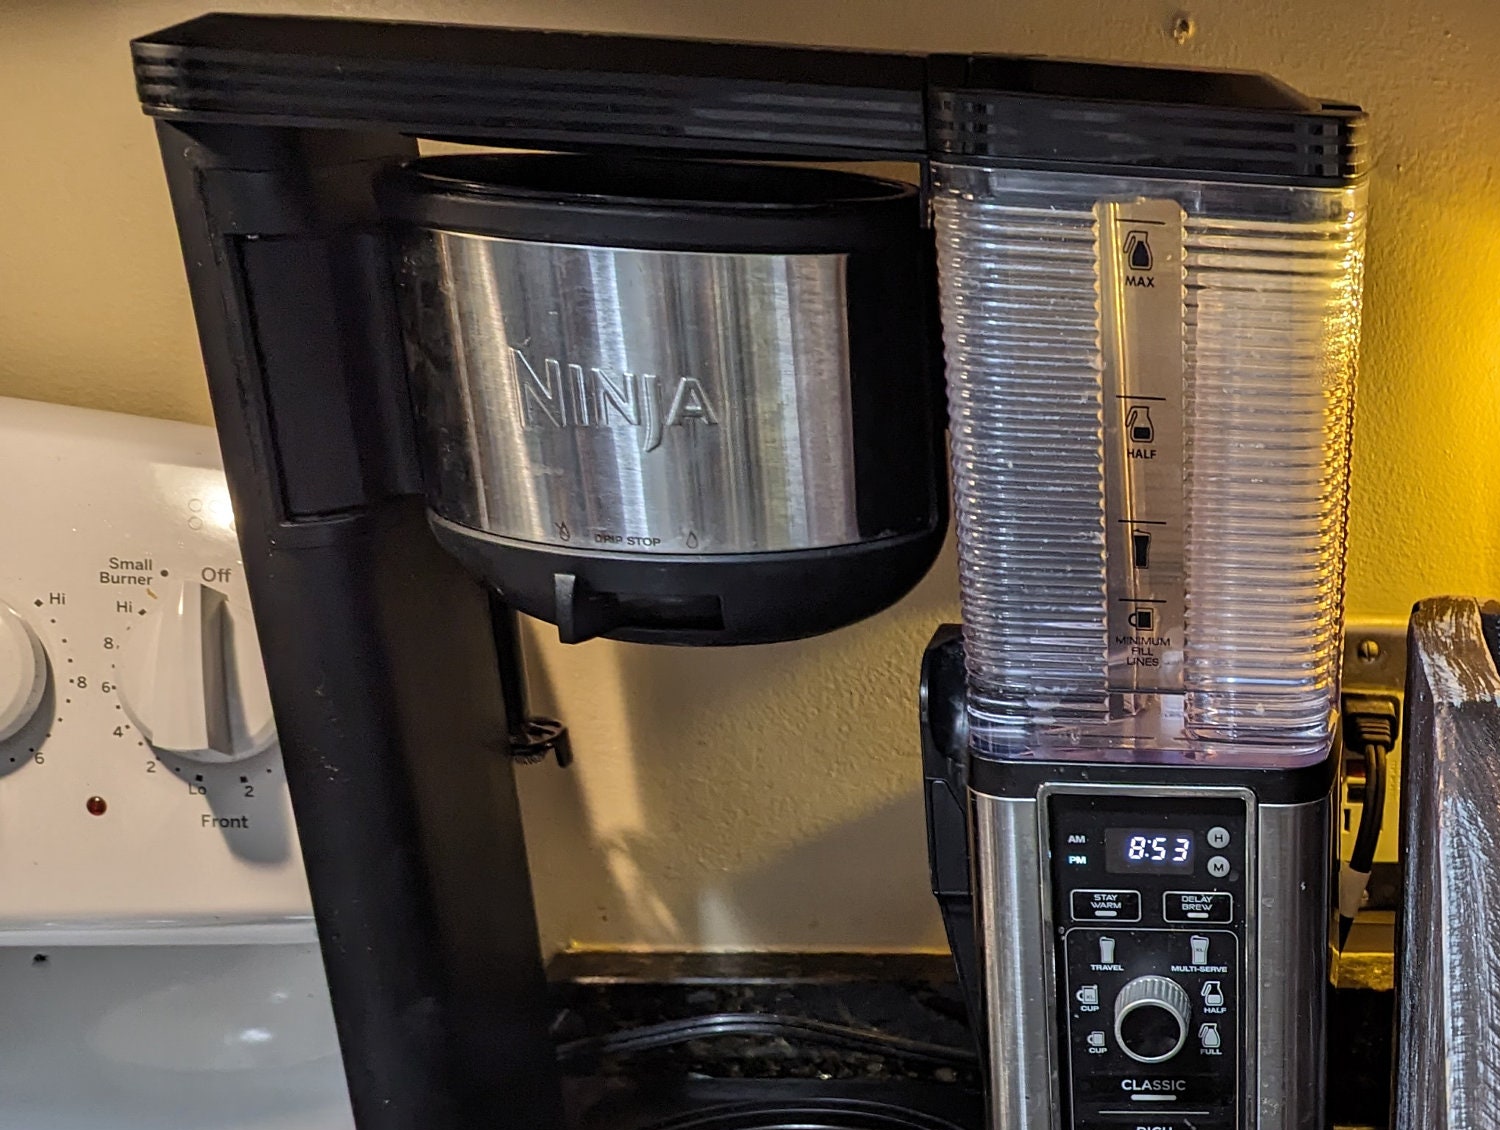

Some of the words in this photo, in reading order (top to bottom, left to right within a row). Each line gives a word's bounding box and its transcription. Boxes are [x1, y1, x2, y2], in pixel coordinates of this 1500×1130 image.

[1125, 275, 1155, 288] MAX
[508, 347, 719, 453] NINJA
[1126, 448, 1157, 459] HALF
[594, 533, 623, 544] DRIP
[626, 535, 661, 547] STOP
[109, 557, 153, 571] Small
[100, 572, 153, 586] Burner
[201, 567, 232, 583] Off
[50, 593, 66, 605] Hi
[116, 601, 133, 613] Hi
[103, 637, 114, 649] 8
[1126, 656, 1159, 667] LINES
[77, 676, 87, 688] 8
[101, 682, 111, 693] 6
[113, 727, 123, 738] 4
[34, 752, 45, 764] 6
[146, 762, 156, 773] 2
[189, 783, 207, 796] Lo
[244, 786, 254, 798] 2
[202, 814, 249, 829] Front
[1068, 835, 1086, 844] AM
[1214, 834, 1223, 842] H
[1128, 836, 1190, 862] 8:53
[1068, 856, 1087, 865] PM
[1213, 863, 1224, 872] M
[1090, 901, 1122, 909] WARM
[1181, 895, 1213, 903] DELAY
[1181, 903, 1213, 911] BREW
[1090, 964, 1124, 972] TRAVEL
[1171, 965, 1228, 973] MULTI-SERVE
[1203, 1006, 1227, 1014] HALF
[1121, 1079, 1186, 1091] CLASSIC
